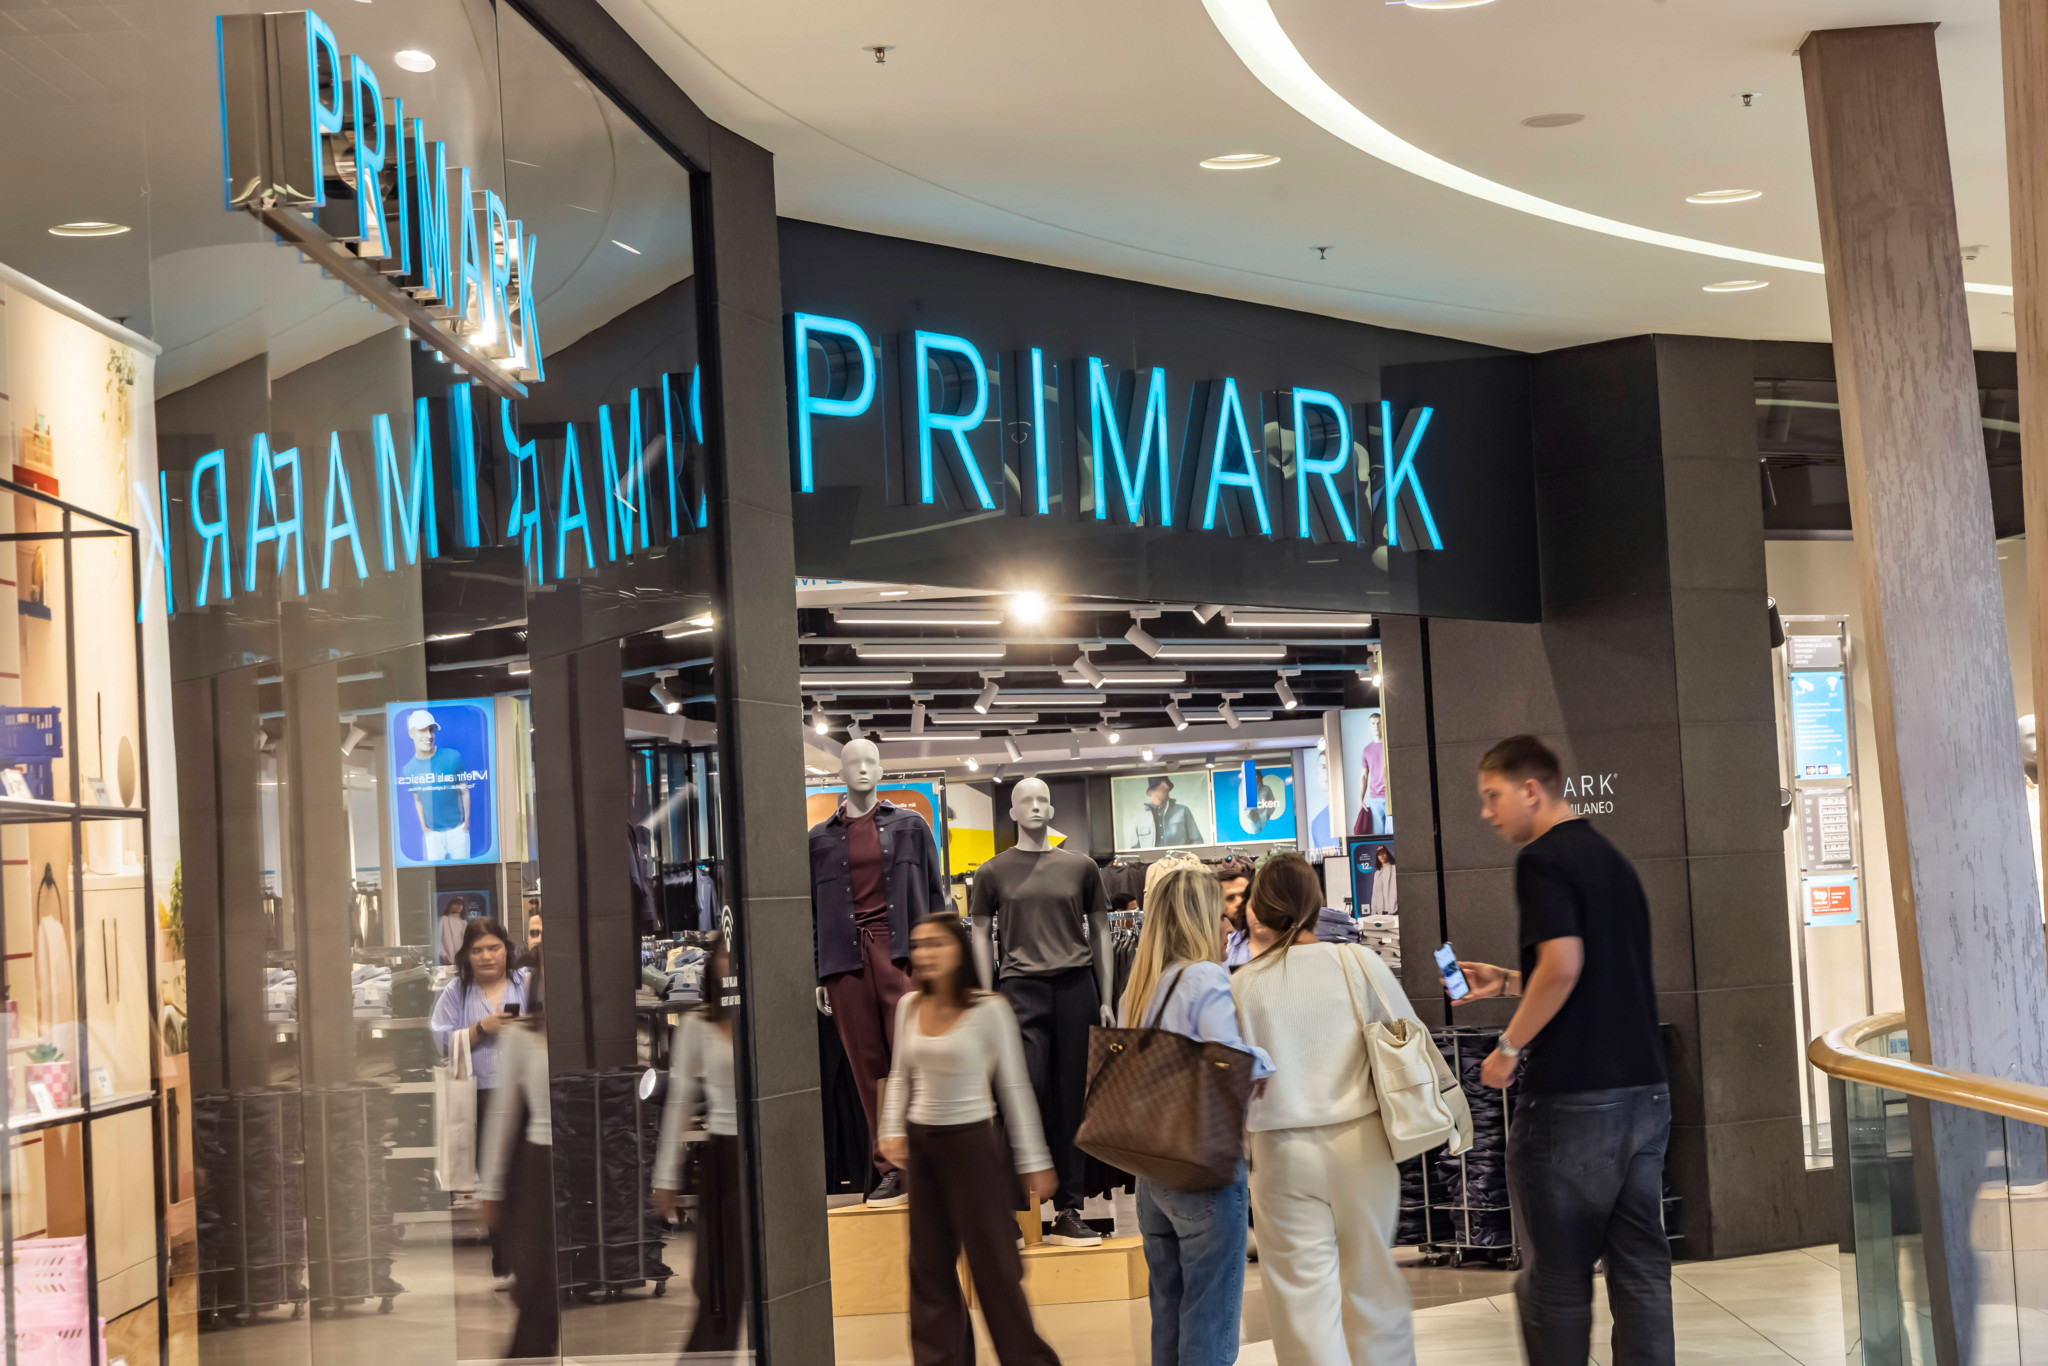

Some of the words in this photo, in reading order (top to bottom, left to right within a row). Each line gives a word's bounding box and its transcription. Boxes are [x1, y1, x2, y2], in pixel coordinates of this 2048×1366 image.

[306, 9, 545, 382] PRIMARK
[794, 312, 1444, 551] PRIMARK
[1257, 798, 1280, 810] cken
[1563, 773, 1614, 798] ARK
